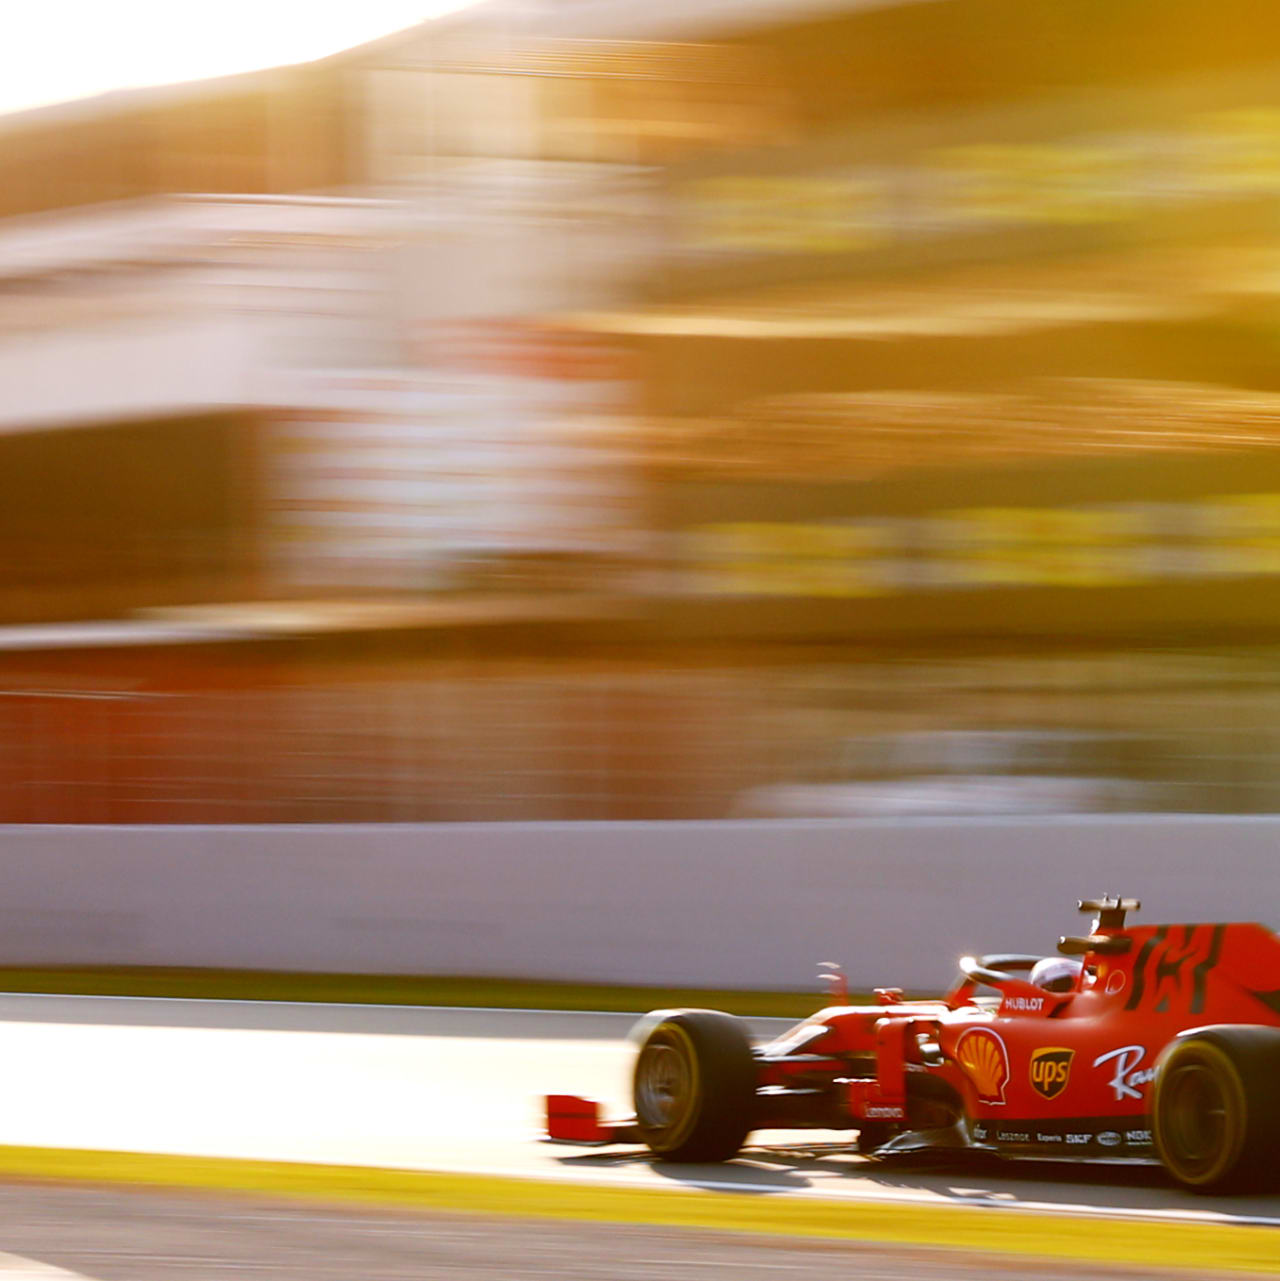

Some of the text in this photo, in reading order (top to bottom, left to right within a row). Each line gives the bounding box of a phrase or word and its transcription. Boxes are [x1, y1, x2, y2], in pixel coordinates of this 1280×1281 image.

[1005, 997, 1044, 1010] HUBLOT
[1033, 1061, 1068, 1091] ups
[1065, 1134, 1093, 1144] SKF
